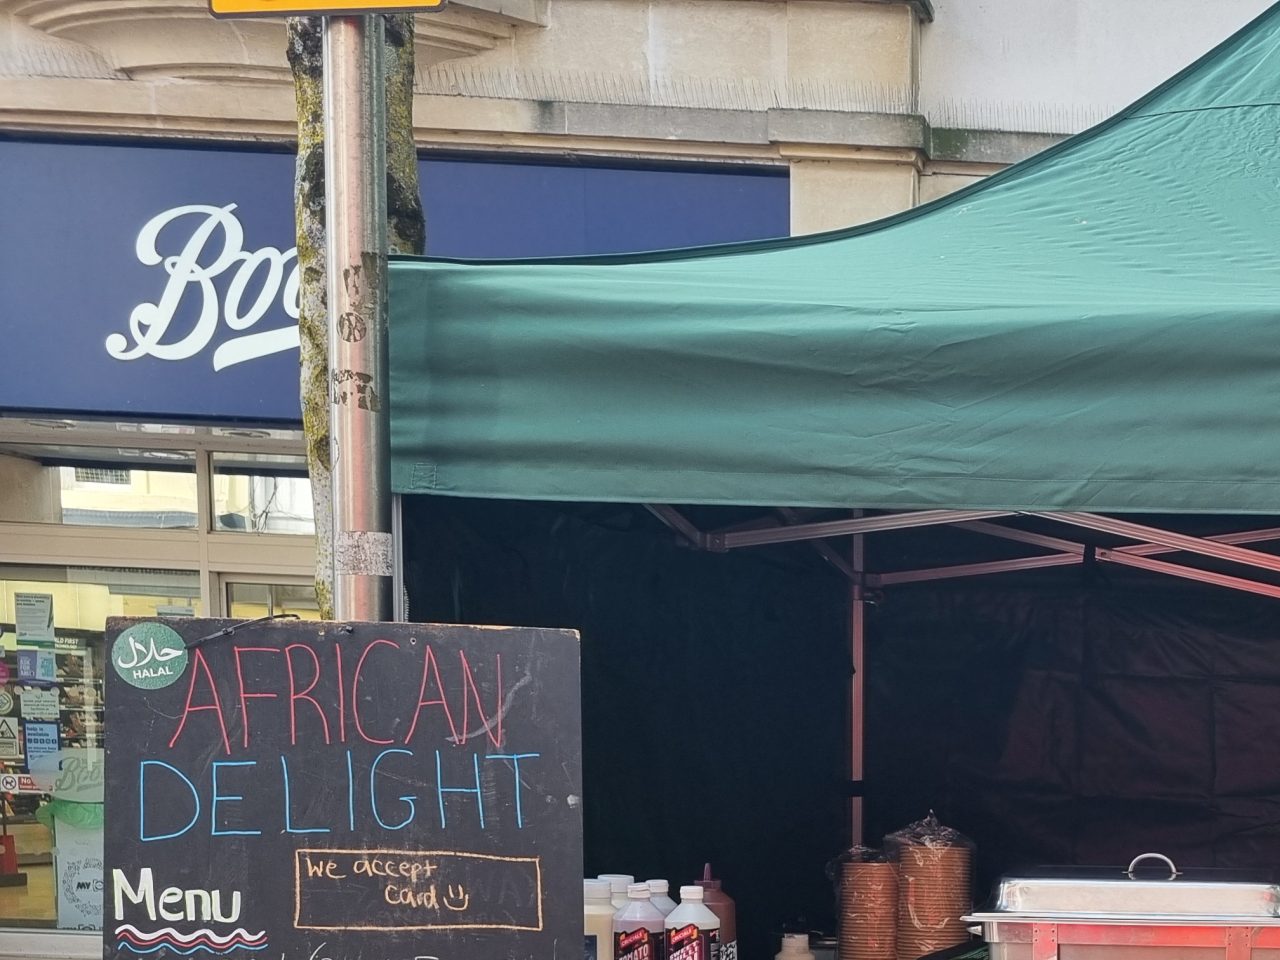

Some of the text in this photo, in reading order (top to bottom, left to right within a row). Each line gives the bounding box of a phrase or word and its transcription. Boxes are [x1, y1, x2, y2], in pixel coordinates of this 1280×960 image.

[133, 666, 173, 679] HALAL
[169, 639, 501, 755] AFRICAN
[140, 749, 541, 841] DELIGHT
[353, 859, 438, 882] accept
[112, 867, 242, 924] Menu
[670, 941, 699, 960] SWEET
